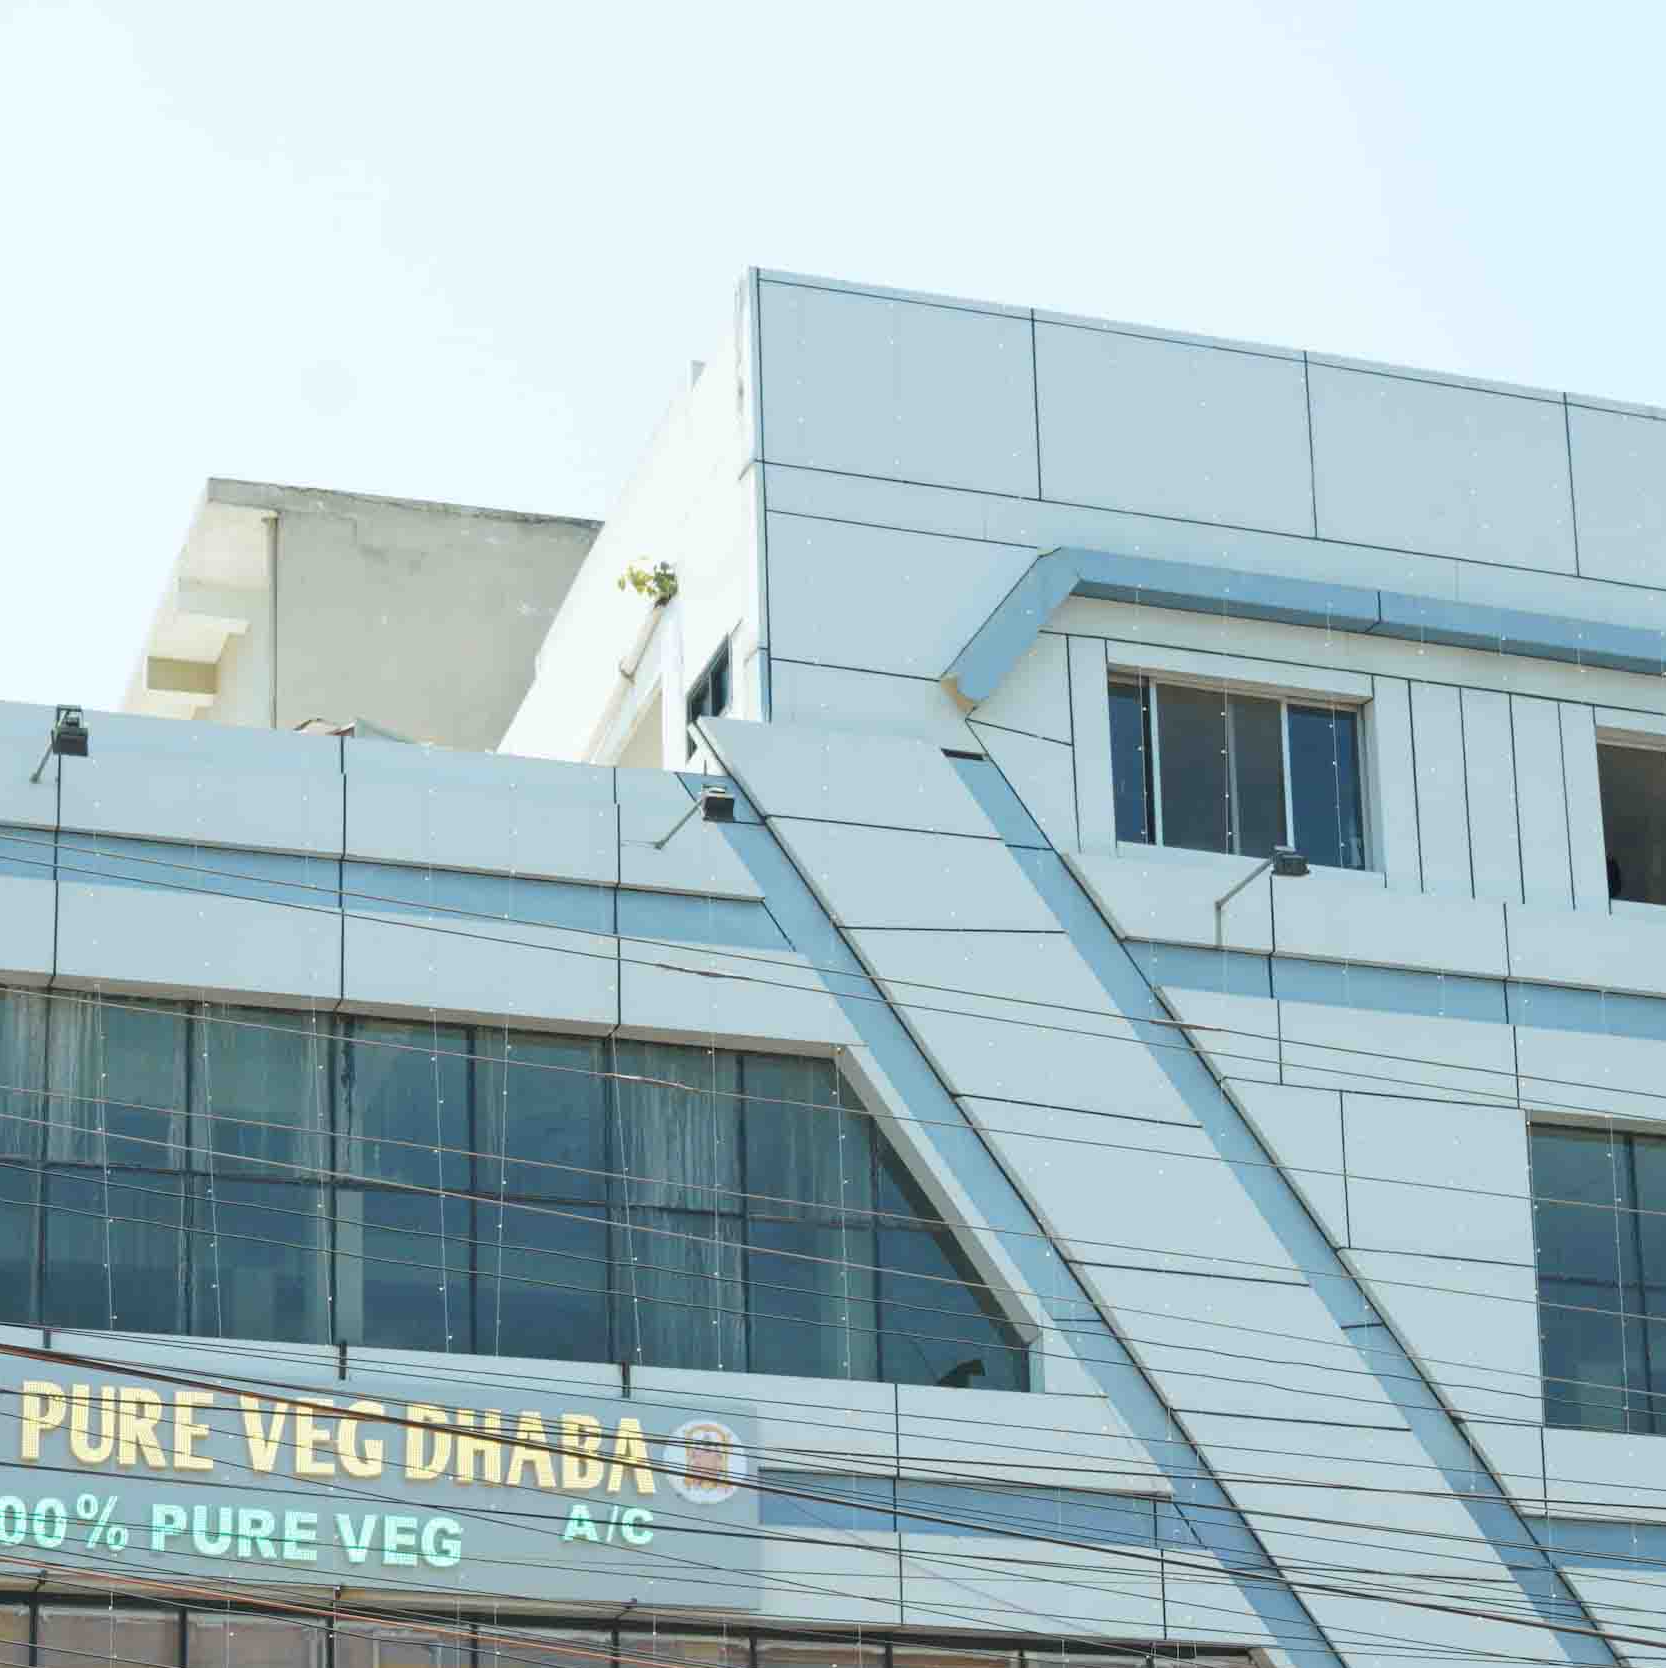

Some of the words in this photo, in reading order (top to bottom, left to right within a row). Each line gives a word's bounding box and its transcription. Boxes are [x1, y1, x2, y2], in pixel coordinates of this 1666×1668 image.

[20, 1379, 216, 1472] PURE
[238, 1393, 387, 1479] VEG
[403, 1401, 657, 1495] DHABA
[151, 1502, 319, 1562] PURE
[334, 1511, 463, 1568] VEG
[561, 1503, 655, 1546] A/C
